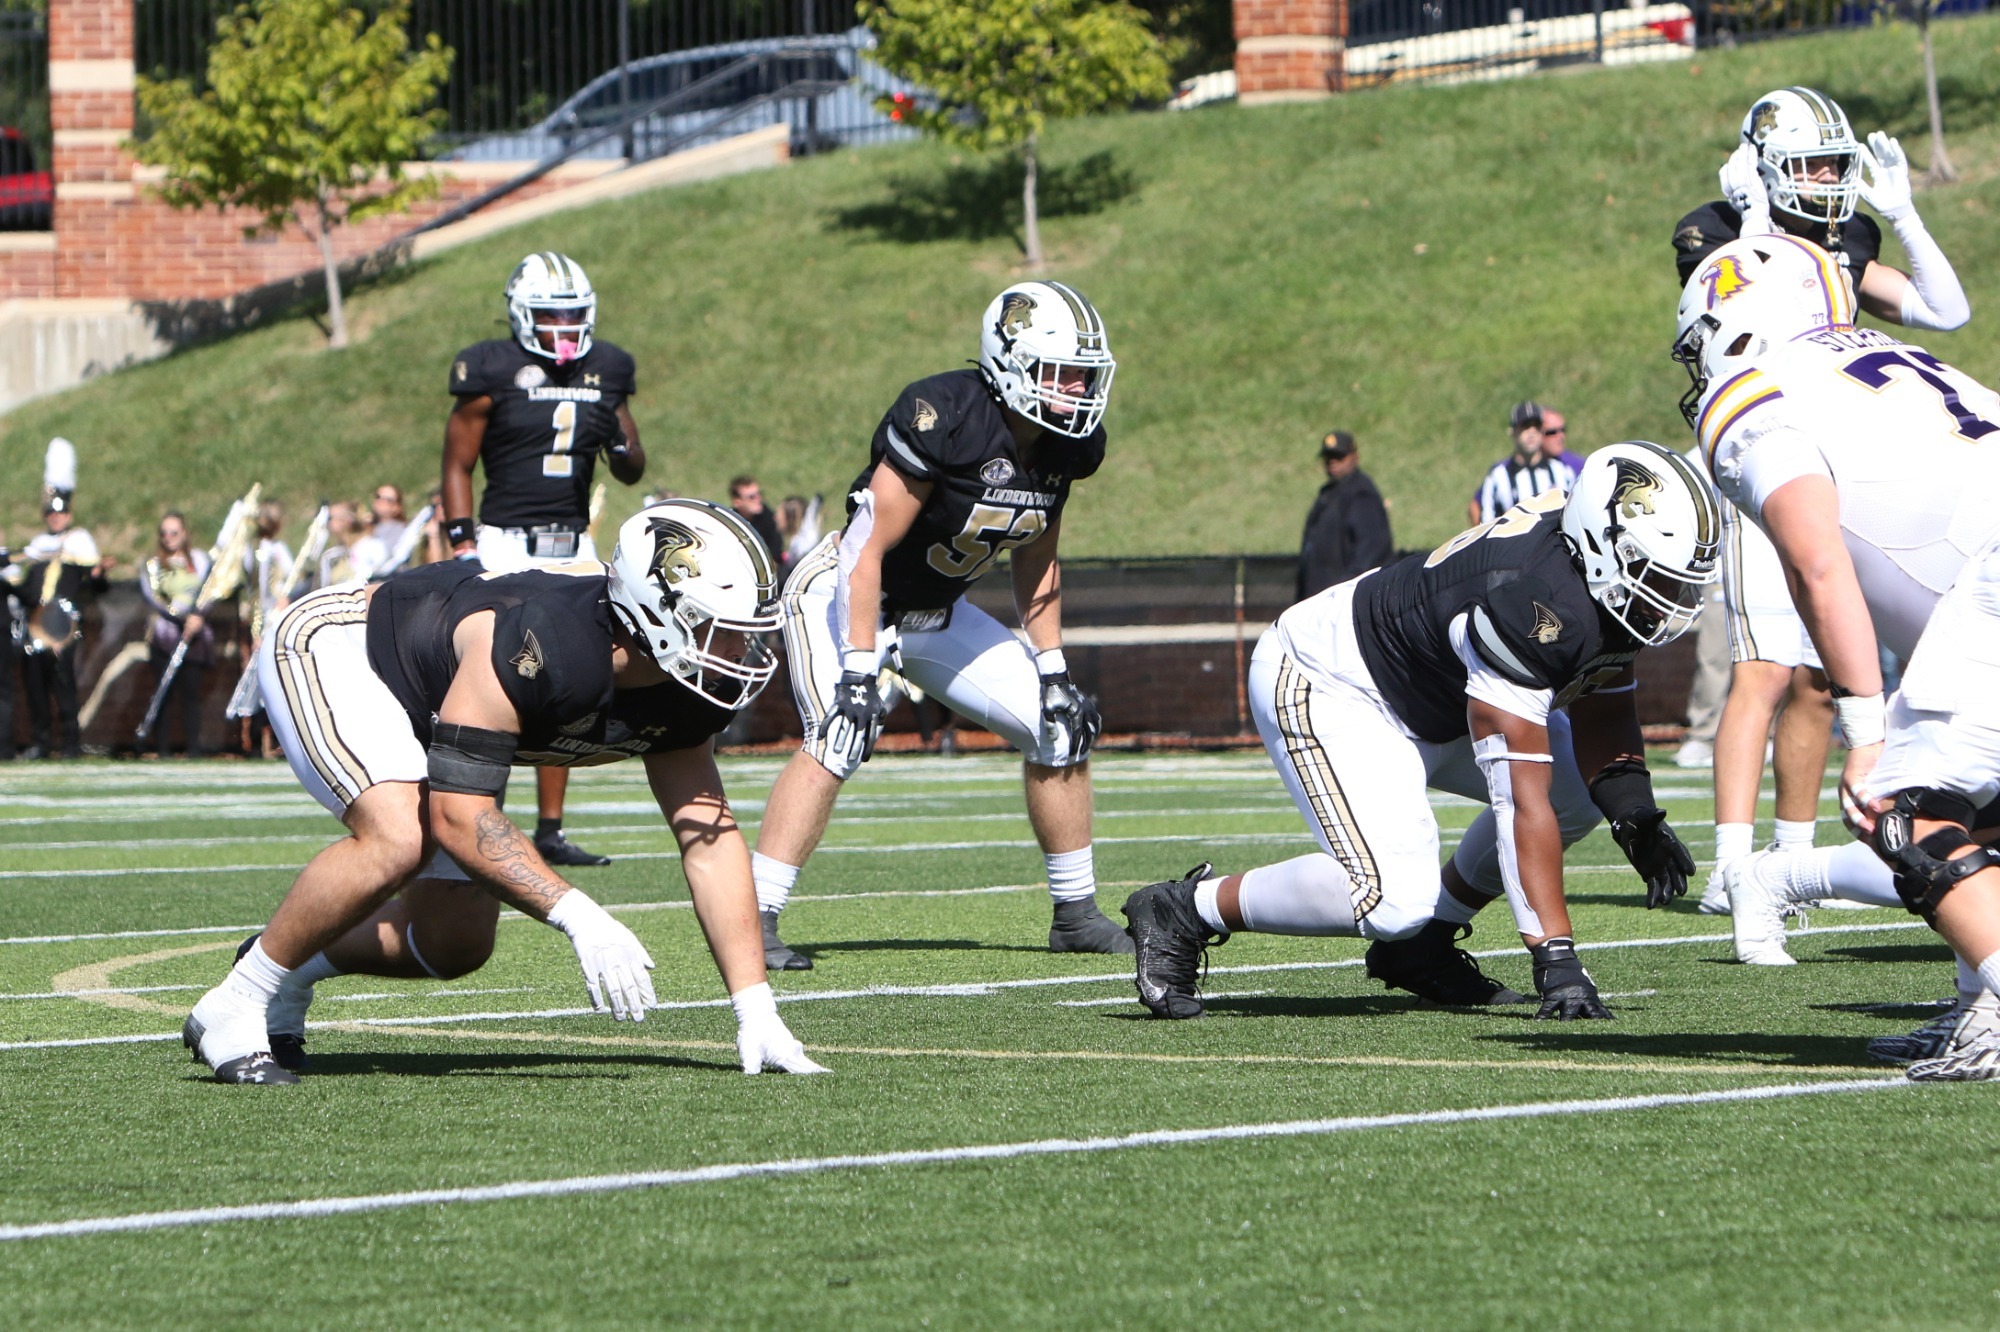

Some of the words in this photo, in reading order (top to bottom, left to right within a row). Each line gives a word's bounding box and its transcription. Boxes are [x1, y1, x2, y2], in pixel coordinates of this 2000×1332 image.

[1811, 312, 1825, 325] 77
[543, 401, 576, 477] 1
[982, 487, 1056, 507] LINDENWOOD
[927, 503, 1047, 581] 52
